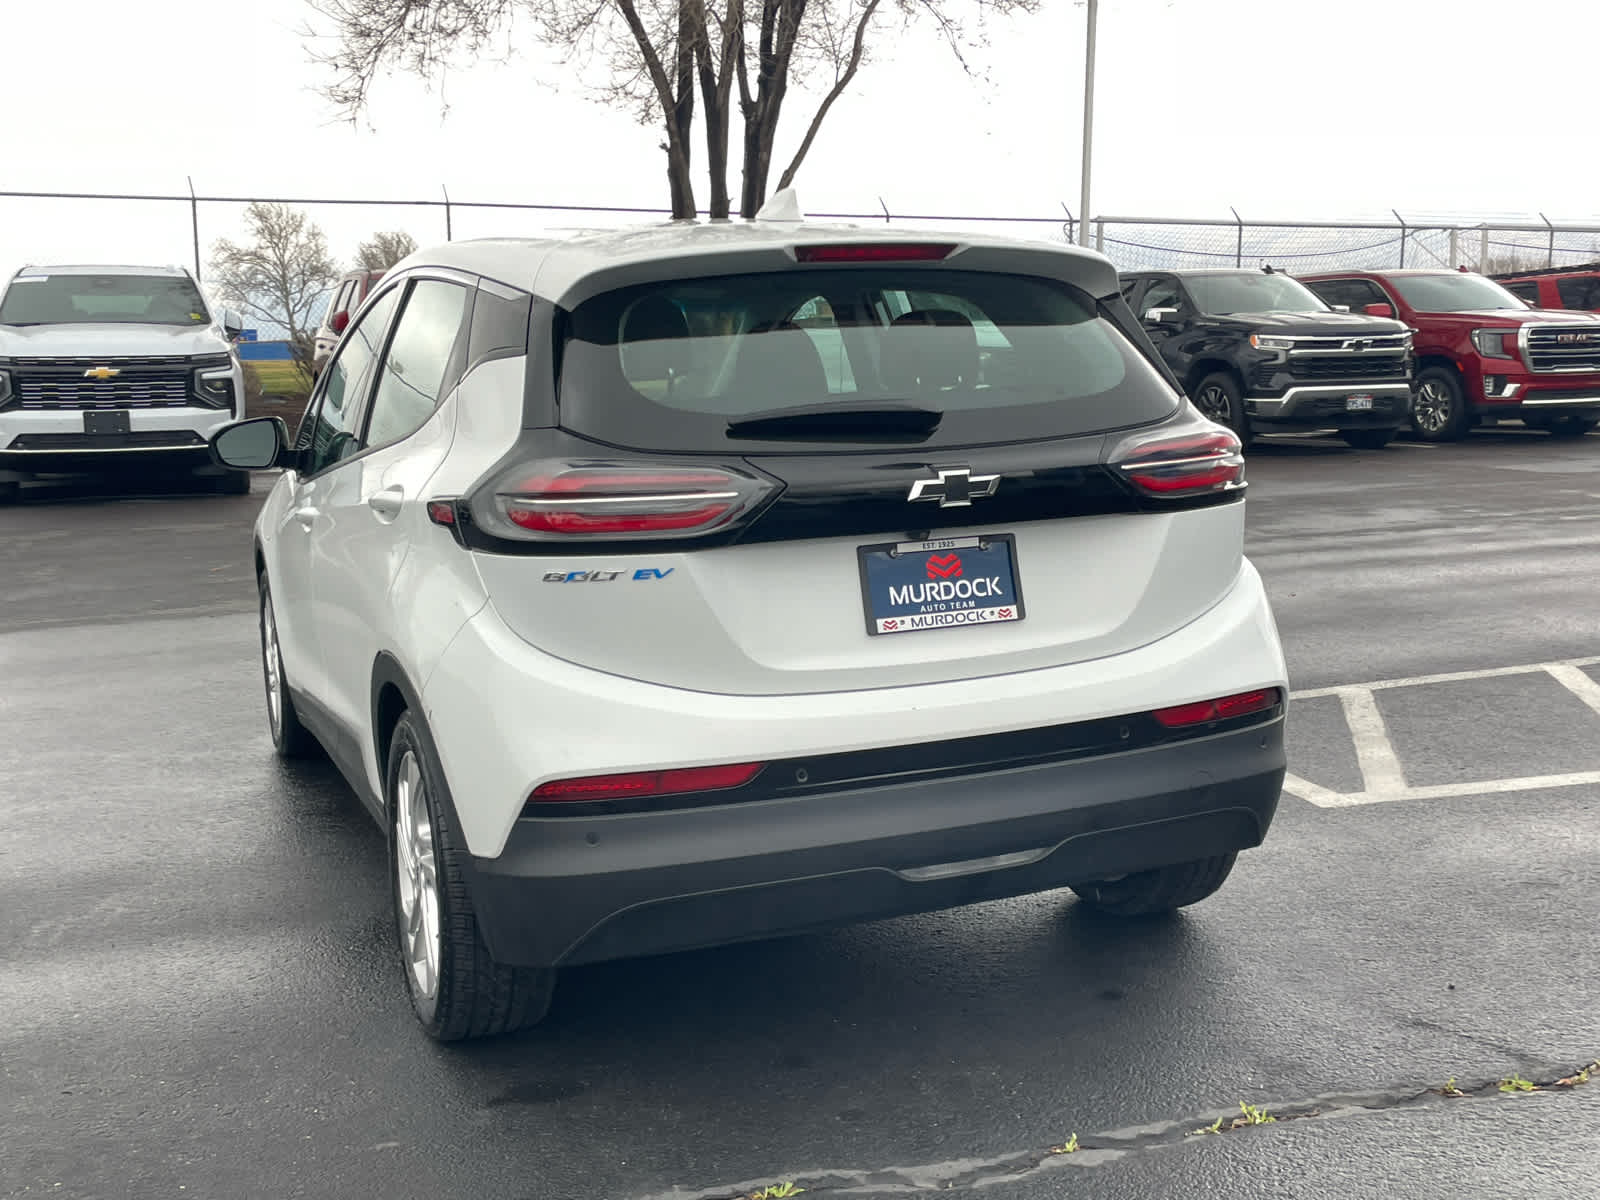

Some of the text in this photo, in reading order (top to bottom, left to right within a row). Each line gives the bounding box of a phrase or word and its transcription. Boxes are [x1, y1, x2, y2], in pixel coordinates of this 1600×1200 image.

[632, 568, 674, 581] EV
[889, 576, 1002, 606] MURDOCK
[920, 600, 976, 612] AUTO TEAM
[911, 610, 987, 628] MURDOCK
